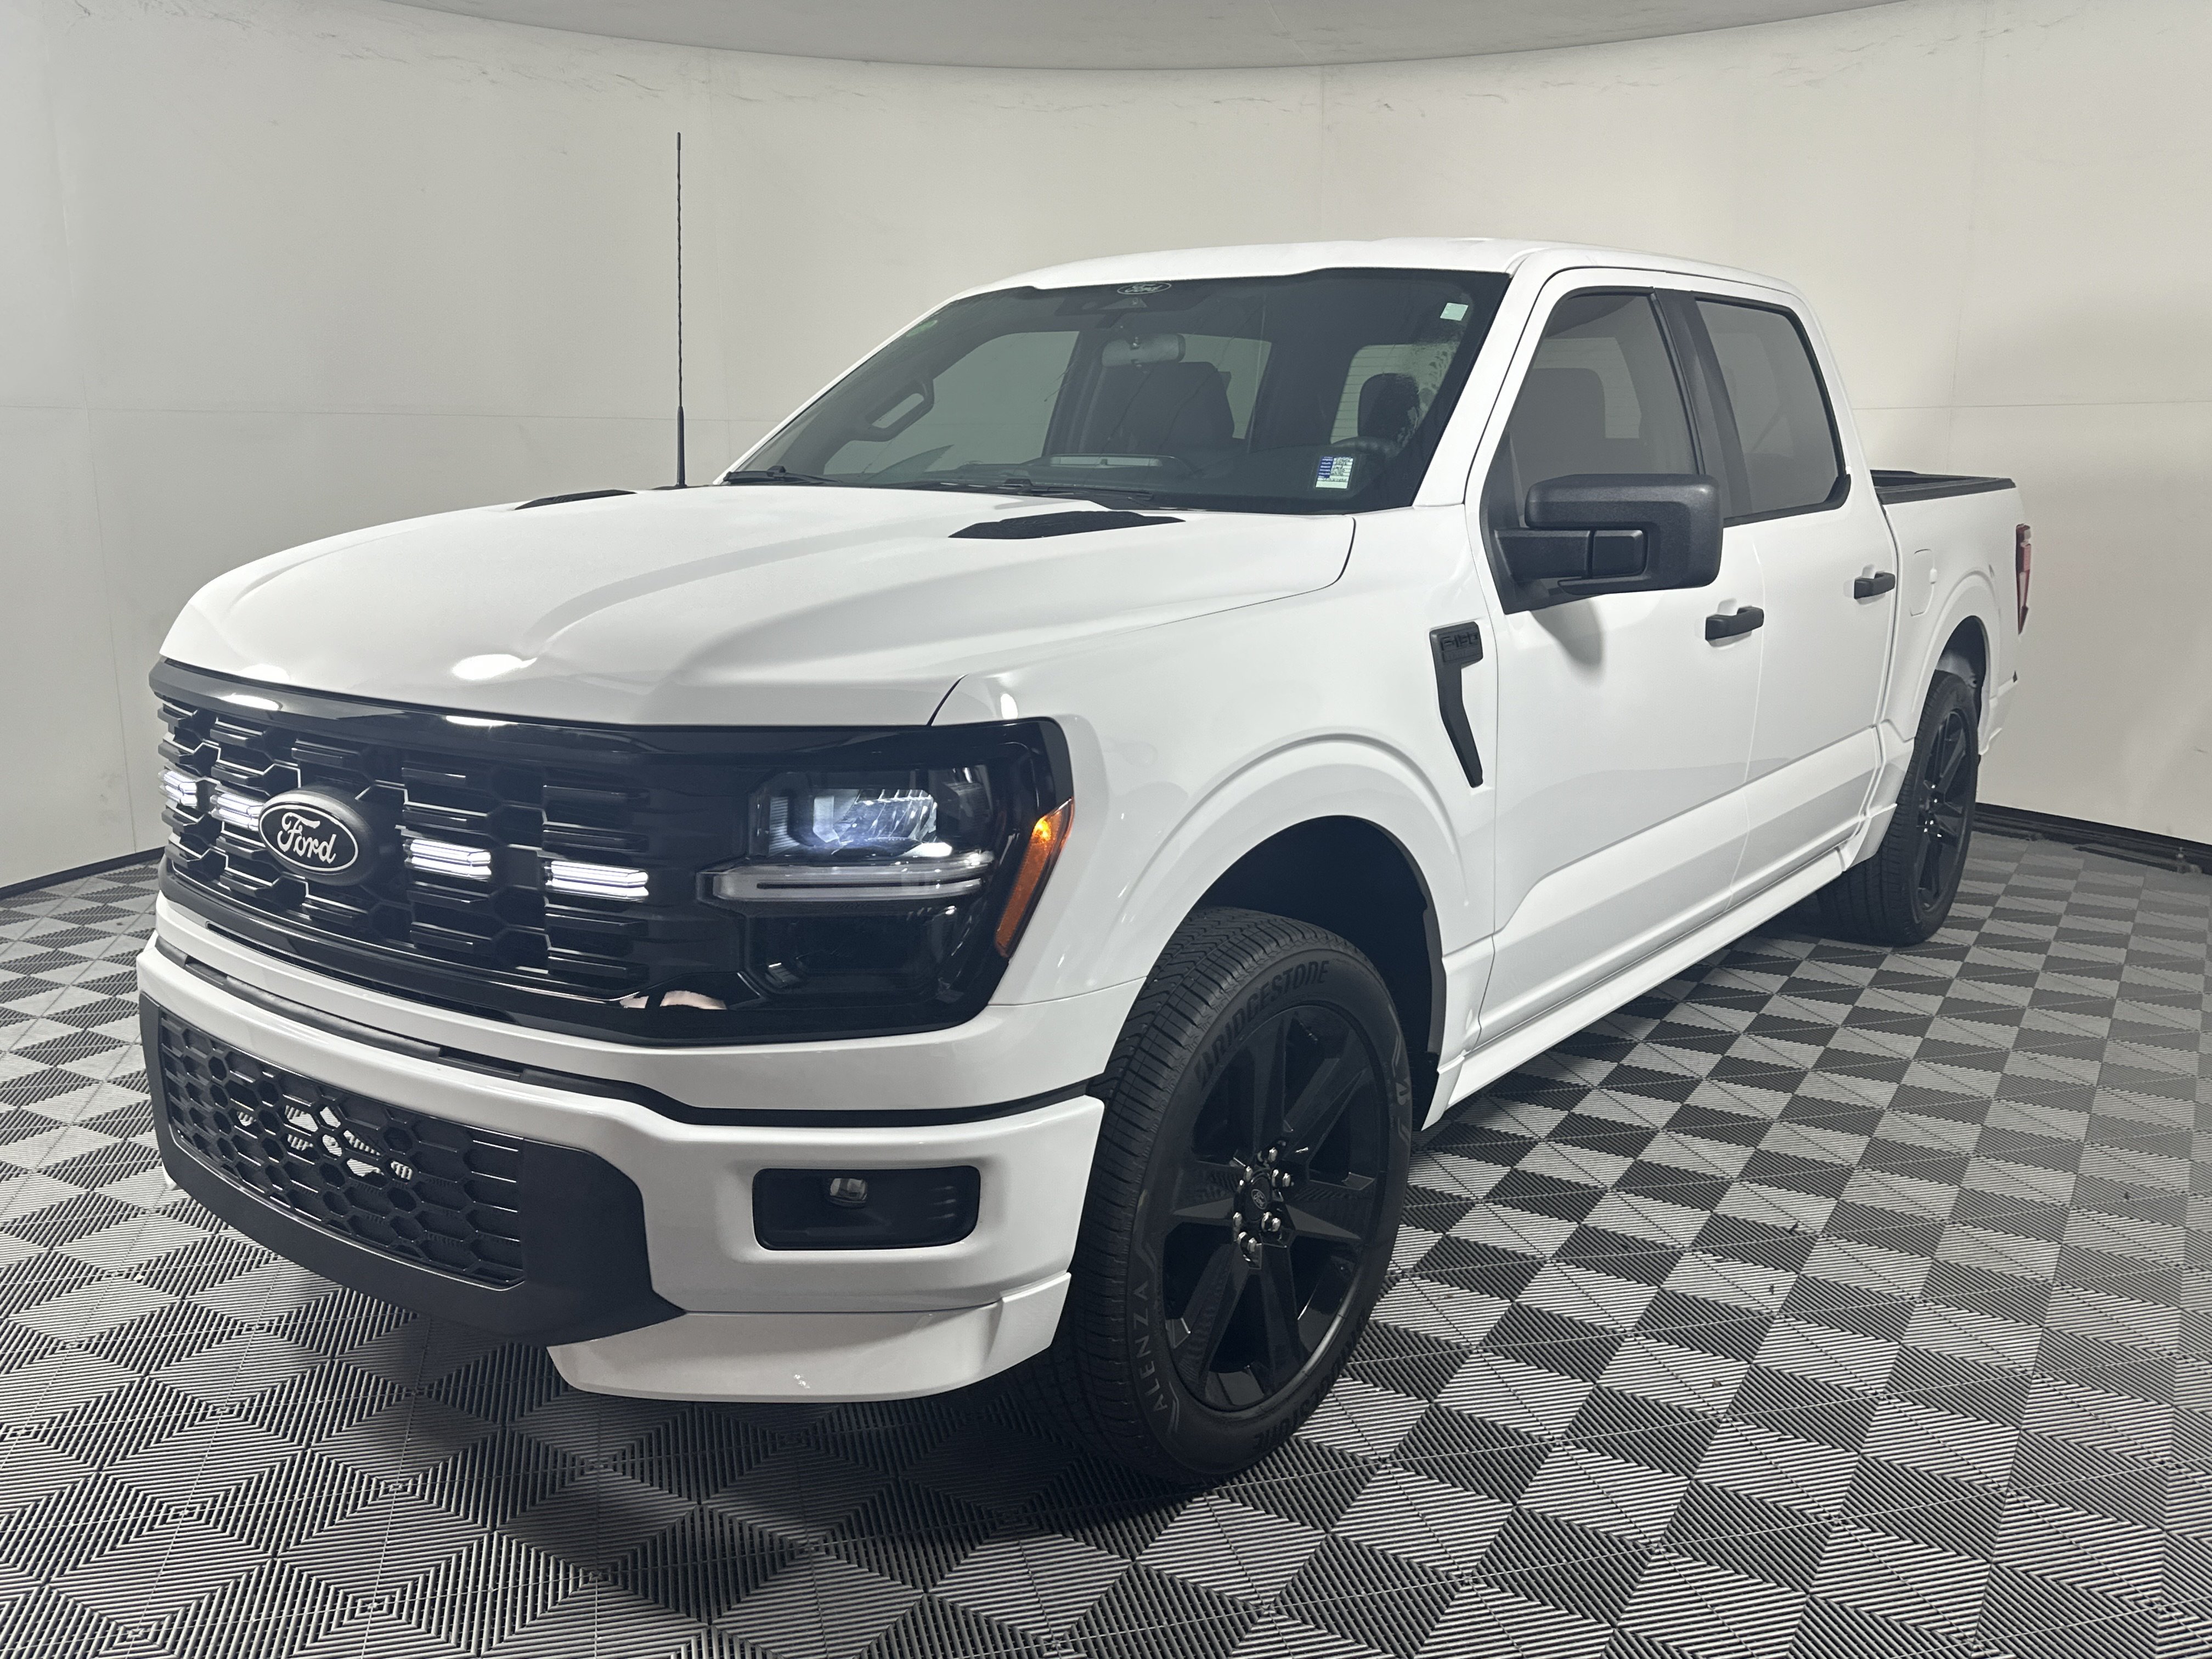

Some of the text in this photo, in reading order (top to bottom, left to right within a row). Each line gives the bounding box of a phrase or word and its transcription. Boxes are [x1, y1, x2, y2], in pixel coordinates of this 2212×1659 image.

[276, 812, 337, 864] Ford
[1194, 960, 1330, 1085] BRIDGESTONE
[1132, 1280, 1168, 1413] ALENZA
